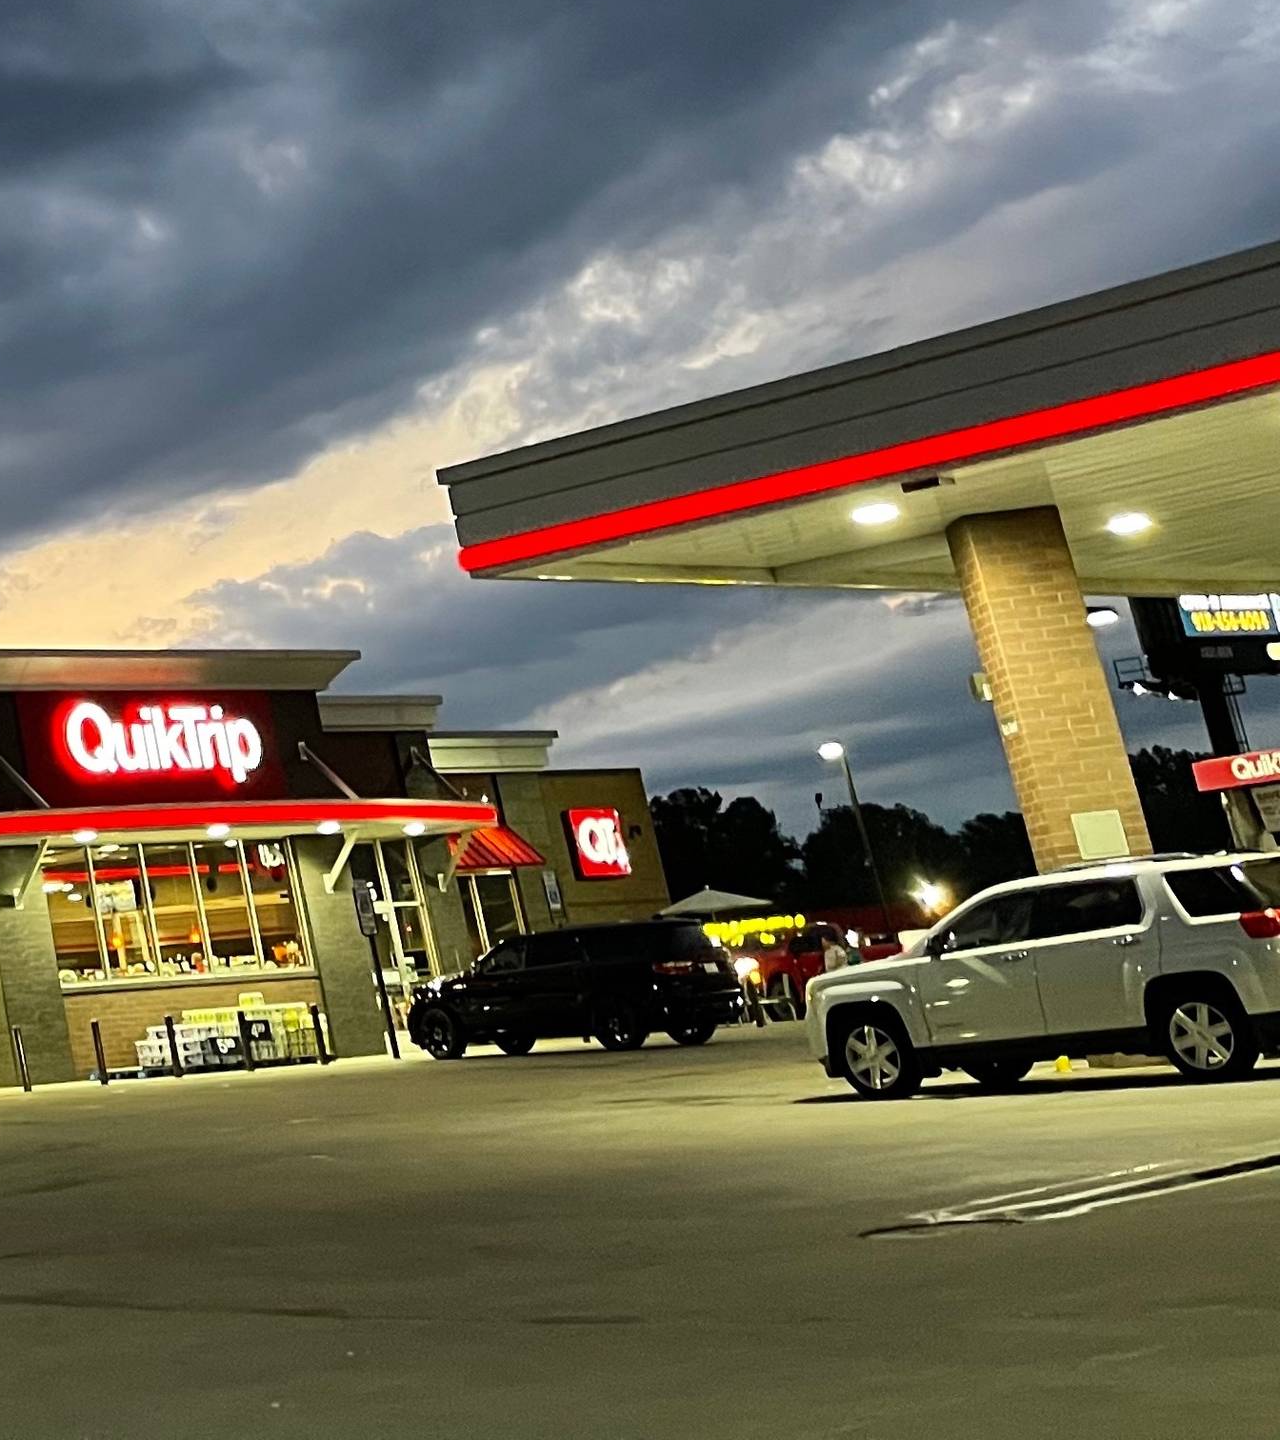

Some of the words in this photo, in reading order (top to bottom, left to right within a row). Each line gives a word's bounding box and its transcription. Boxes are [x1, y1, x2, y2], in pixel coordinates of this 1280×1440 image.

[66, 702, 262, 783] QuikTrip
[1231, 751, 1280, 779] Quik
[578, 817, 616, 865] QT
